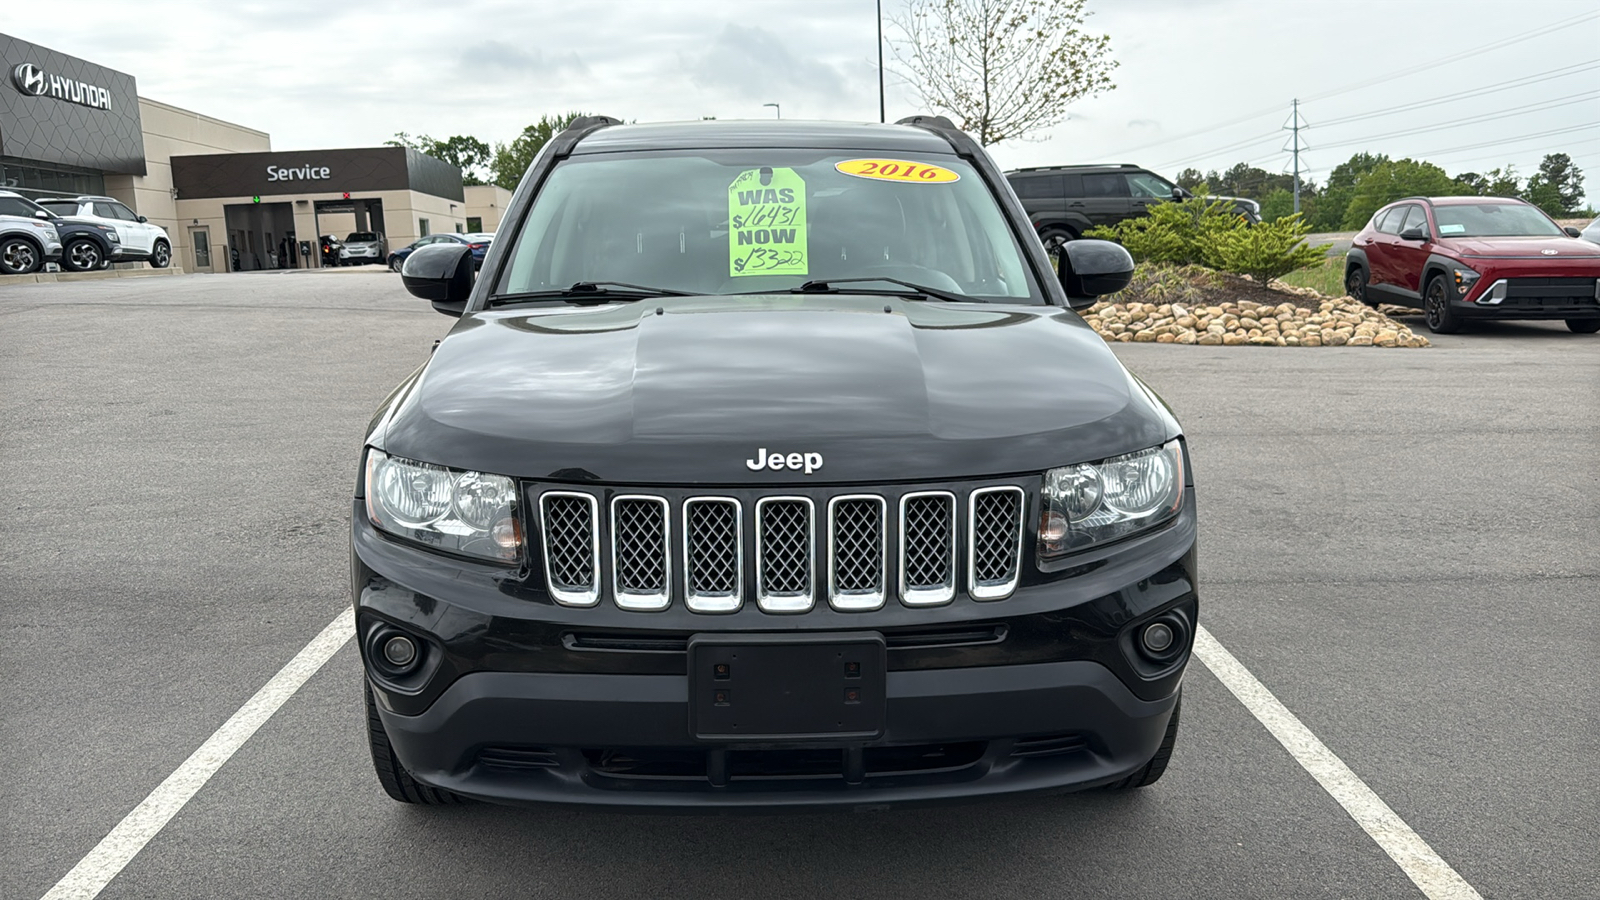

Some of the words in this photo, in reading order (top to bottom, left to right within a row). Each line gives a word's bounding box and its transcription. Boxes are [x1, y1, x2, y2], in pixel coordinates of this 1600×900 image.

[50, 73, 112, 110] HYUNDAI
[267, 163, 331, 181] Service
[857, 162, 940, 179] 2016
[737, 188, 795, 206] WAS
[737, 228, 797, 246] NOW
[746, 448, 823, 474] Jeep
